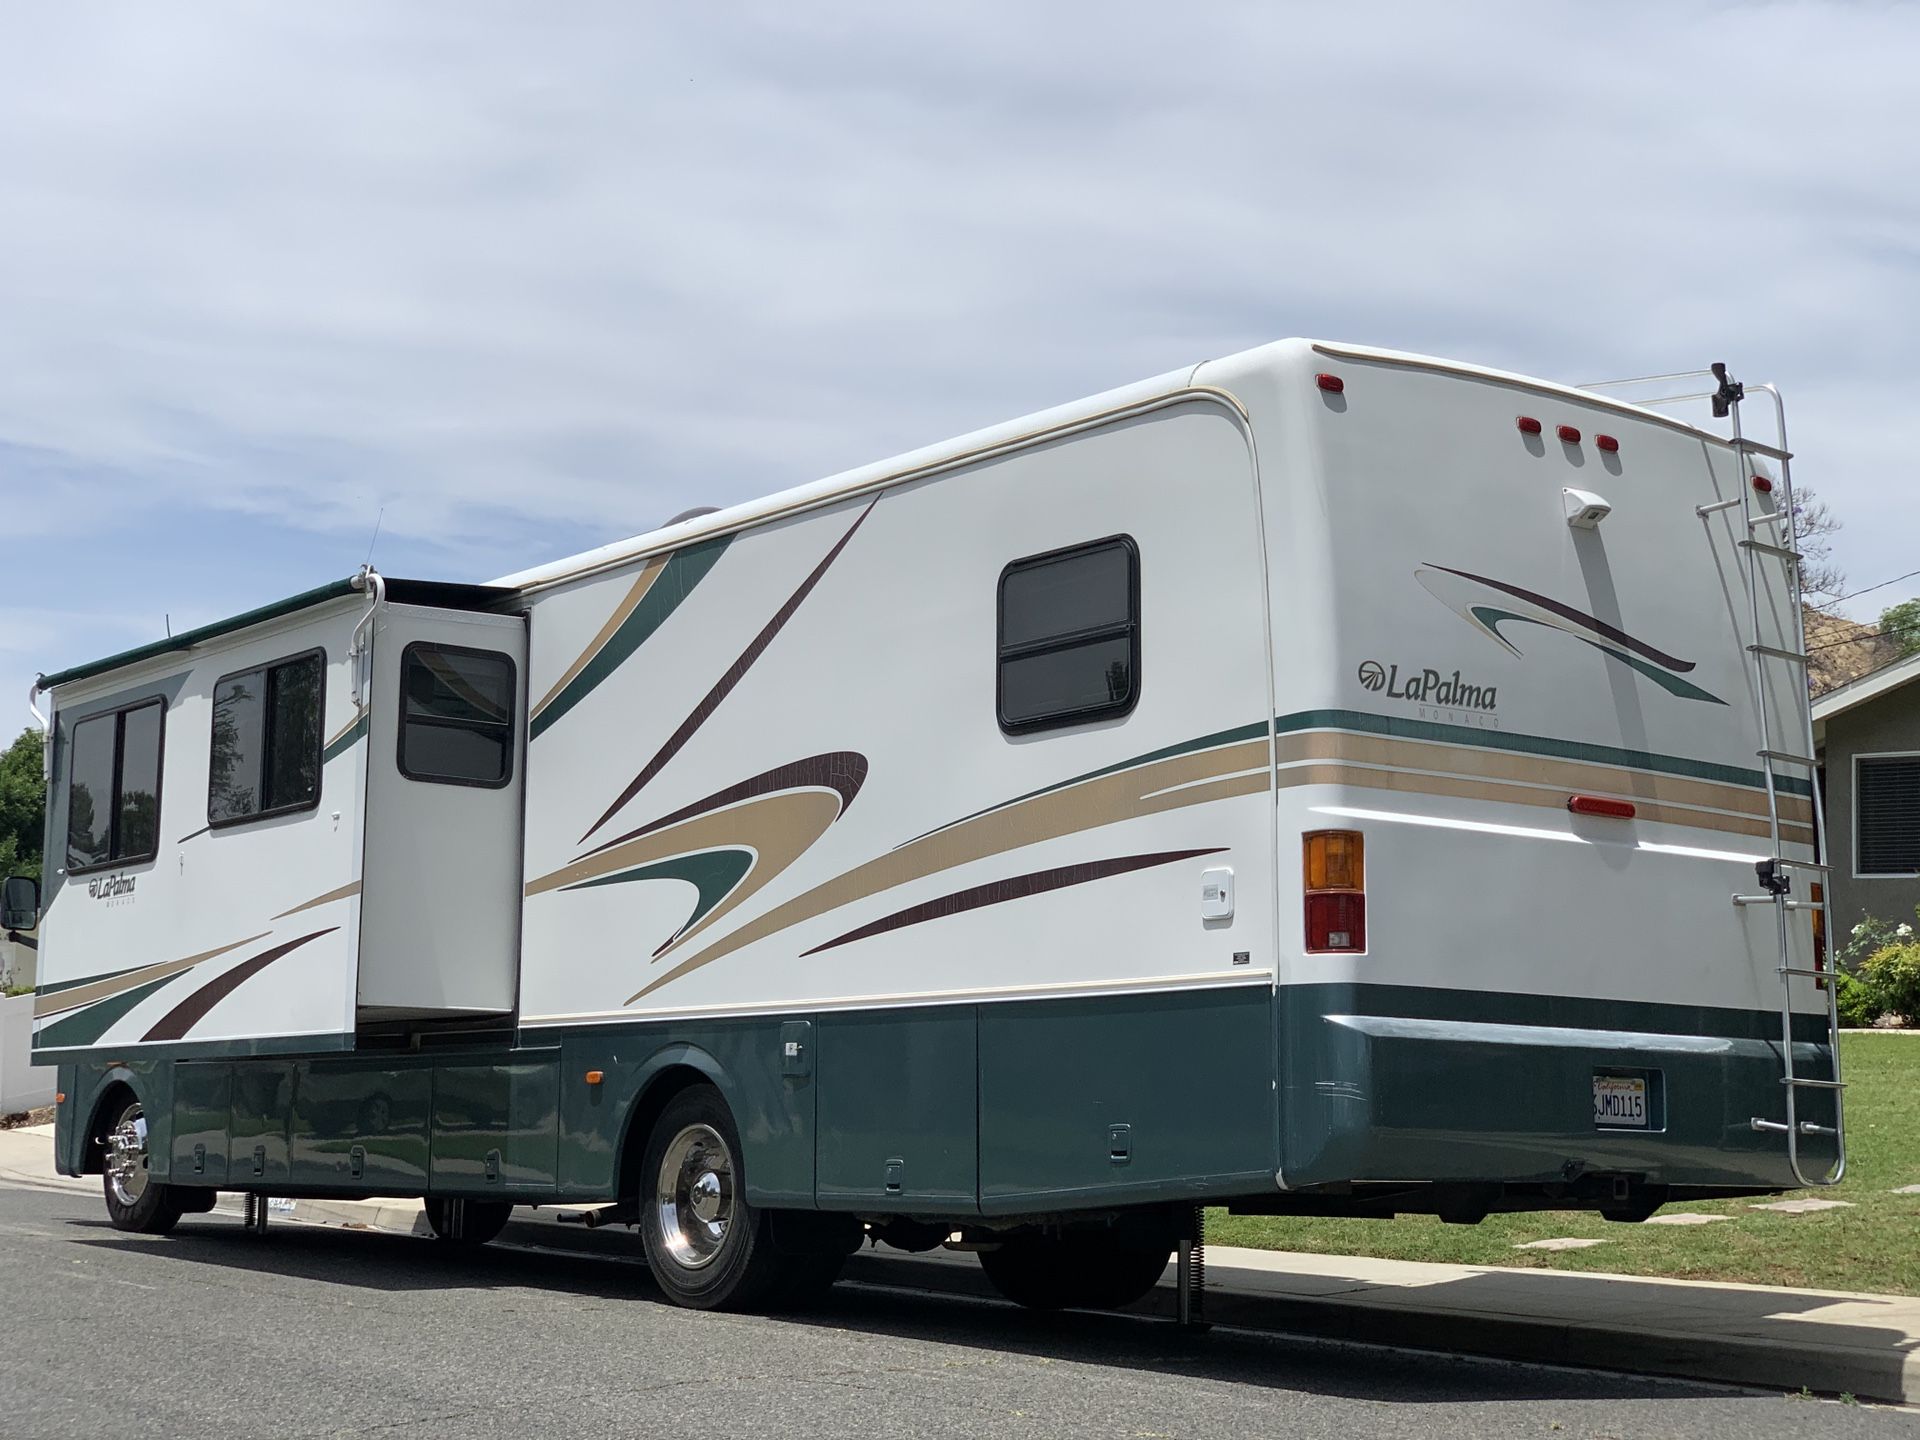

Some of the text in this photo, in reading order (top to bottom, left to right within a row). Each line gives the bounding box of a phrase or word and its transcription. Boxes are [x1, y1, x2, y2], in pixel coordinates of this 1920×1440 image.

[1386, 664, 1497, 710] LaPalma
[1419, 707, 1499, 729] MONACO
[97, 871, 136, 900] LaPalma
